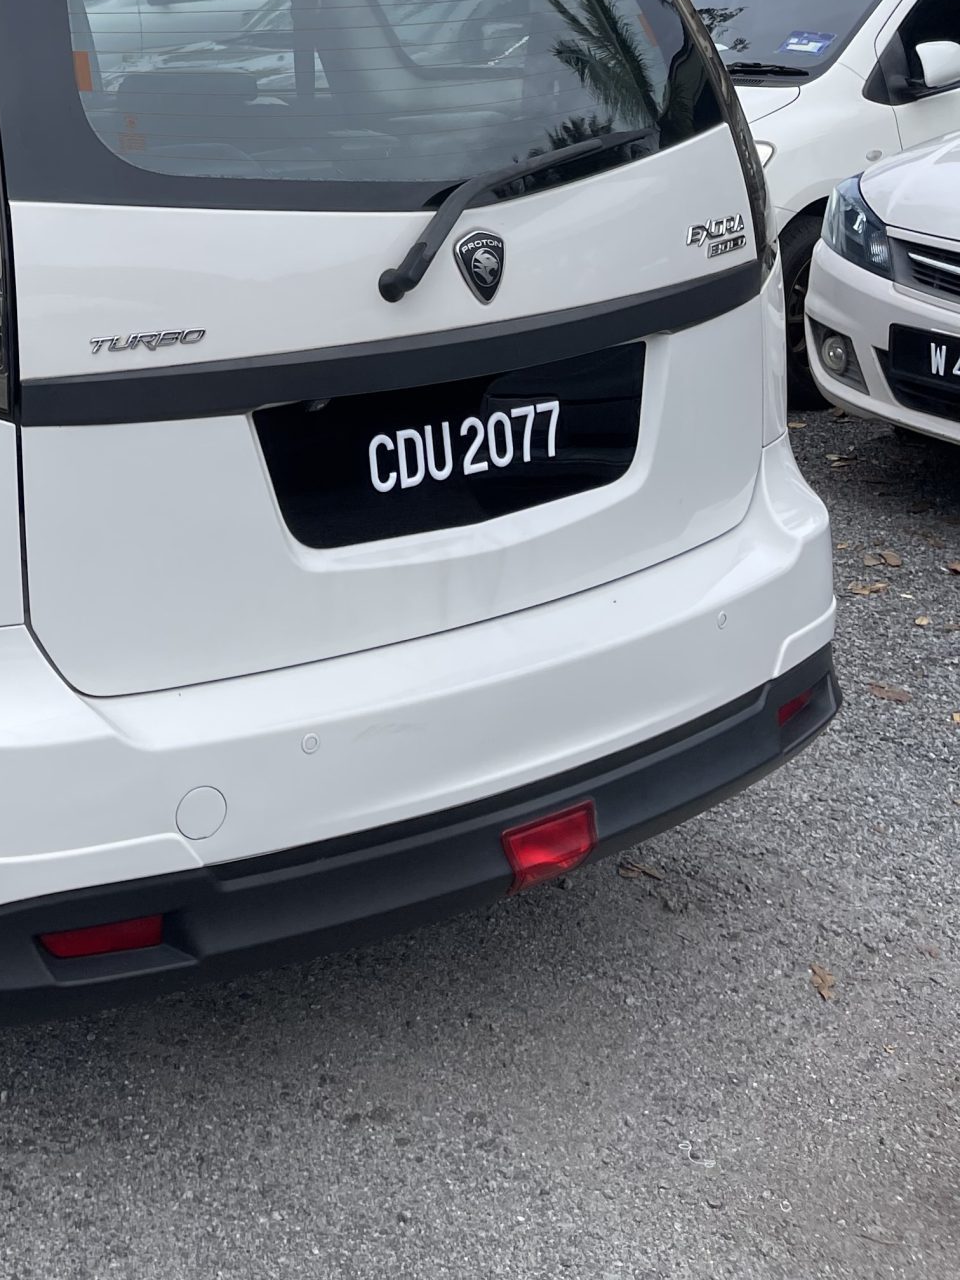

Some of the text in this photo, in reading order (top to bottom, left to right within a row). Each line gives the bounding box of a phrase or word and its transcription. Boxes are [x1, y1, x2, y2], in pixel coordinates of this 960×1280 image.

[461, 239, 502, 253] PROTON
[89, 327, 206, 354] TURBO
[930, 342, 947, 376] W
[368, 400, 560, 493] CDU 2077
